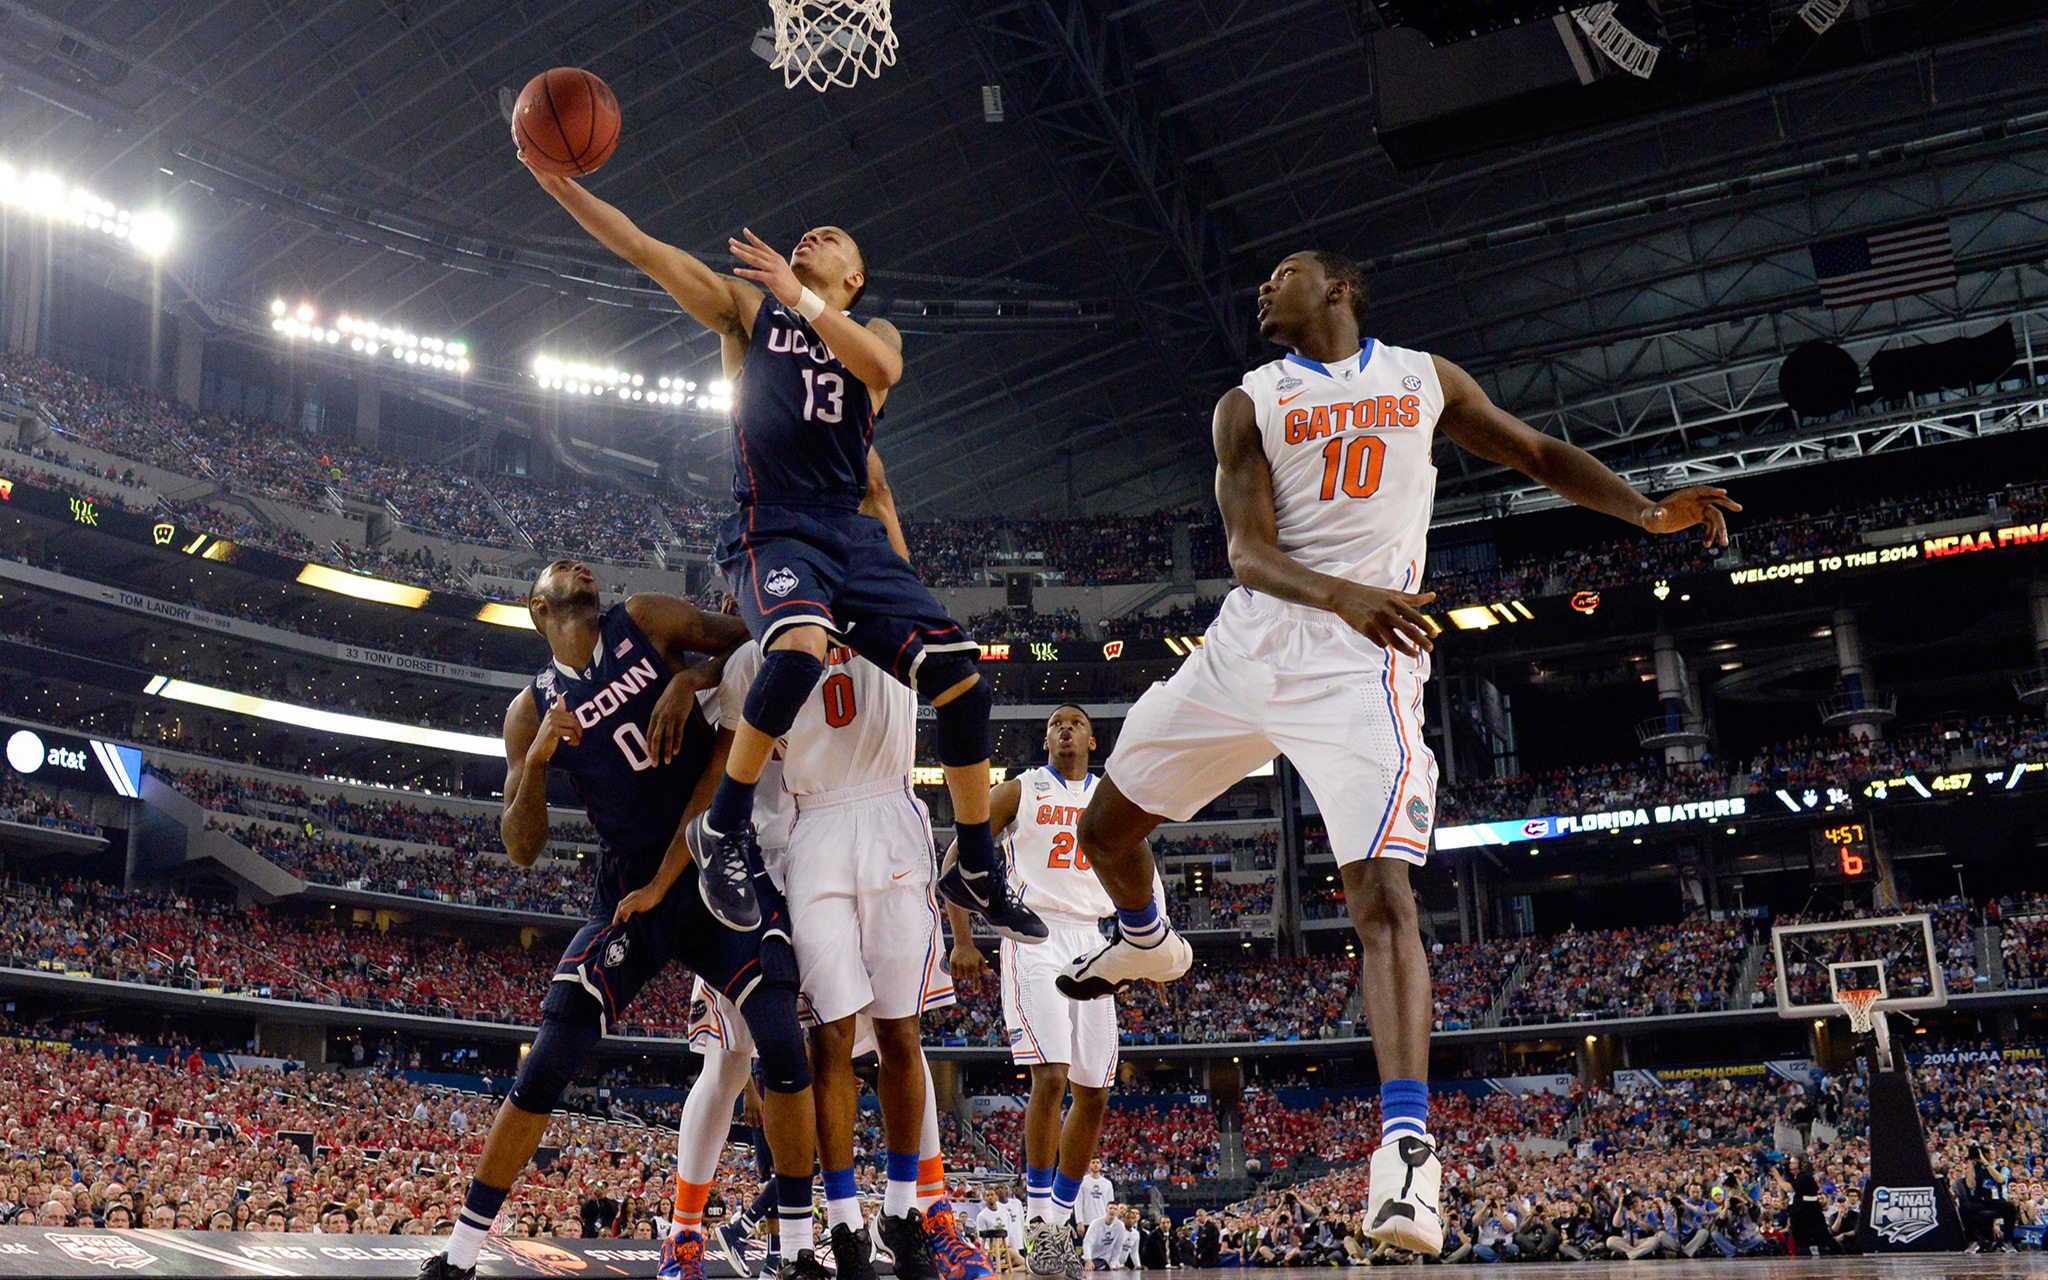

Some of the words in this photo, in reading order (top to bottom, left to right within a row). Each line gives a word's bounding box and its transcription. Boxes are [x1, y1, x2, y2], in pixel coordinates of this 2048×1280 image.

[768, 327, 846, 369] UCO
[801, 369, 845, 424] 13
[1285, 394, 1420, 445] GATORS
[1319, 435, 1387, 501] 10
[1731, 560, 1815, 584] WELCOME
[1819, 556, 1842, 571] TO
[1844, 551, 1877, 568] THE
[1879, 544, 1918, 563] 2014
[1924, 531, 1995, 558] NCAA
[1998, 521, 2048, 547] FINA
[118, 592, 143, 608] TOM
[147, 600, 191, 620] LANDRY
[346, 647, 359, 659] 33
[364, 651, 394, 665] TONY
[396, 657, 447, 675] DORSETT
[558, 657, 658, 736] CONN
[822, 673, 857, 728] 0
[613, 722, 653, 772] 0
[48, 747, 87, 772] at&t
[1931, 773, 1972, 791] 4:57
[1036, 804, 1086, 827] GAT
[1556, 809, 1649, 834] FLORIDA
[1655, 798, 1745, 823] GATORS
[1825, 824, 1863, 844] 4:57
[1789, 1062, 1808, 1071] 122
[1924, 1053, 1956, 1065] 2014
[1958, 1051, 2000, 1063] NCAA
[2003, 1048, 2046, 1060] FINAL
[1555, 1077, 1569, 1085] 121
[1617, 1073, 1635, 1082] 122
[1190, 1095, 1207, 1103] 120
[1890, 1191, 1931, 1206] FINAL
[1875, 1202, 1933, 1224] FOUR
[238, 1245, 317, 1260] AT&T
[584, 1250, 660, 1262] STUDE
